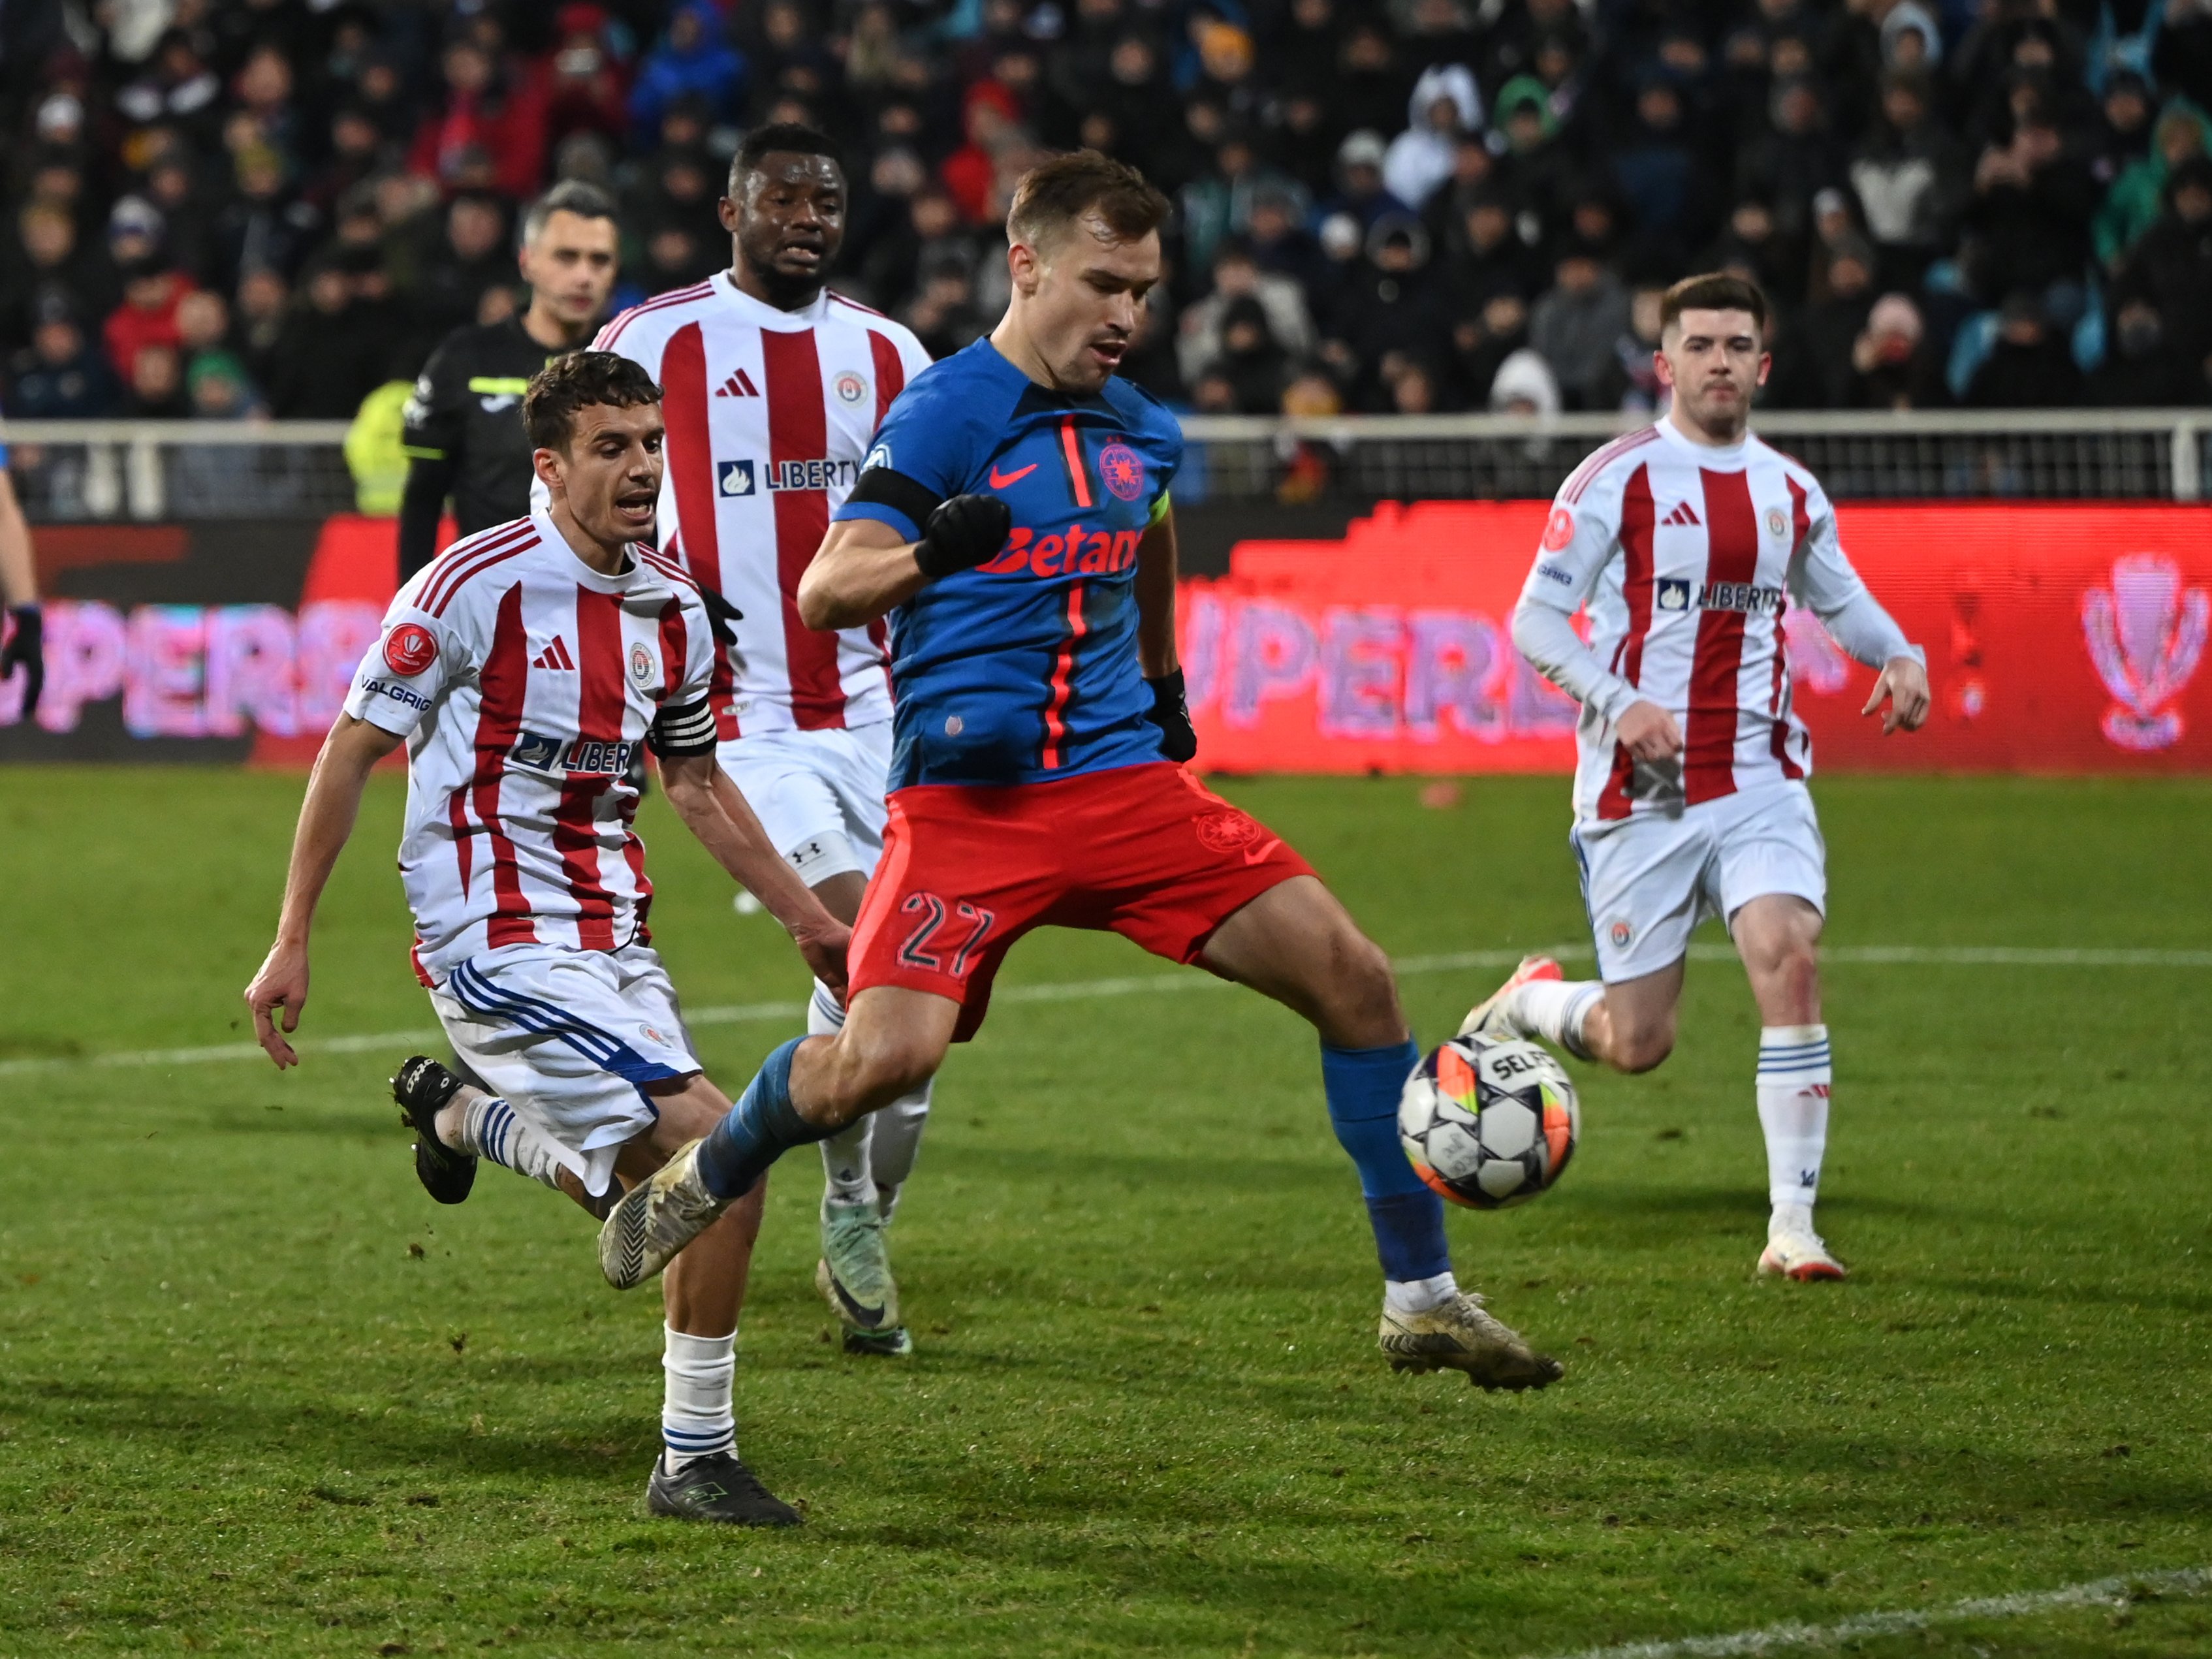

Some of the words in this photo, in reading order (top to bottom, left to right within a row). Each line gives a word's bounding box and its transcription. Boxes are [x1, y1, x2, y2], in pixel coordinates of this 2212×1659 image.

[975, 524, 1146, 577] Betan
[362, 674, 432, 712] VALGRIG
[561, 742, 637, 773] LIBER
[897, 892, 994, 979] 27
